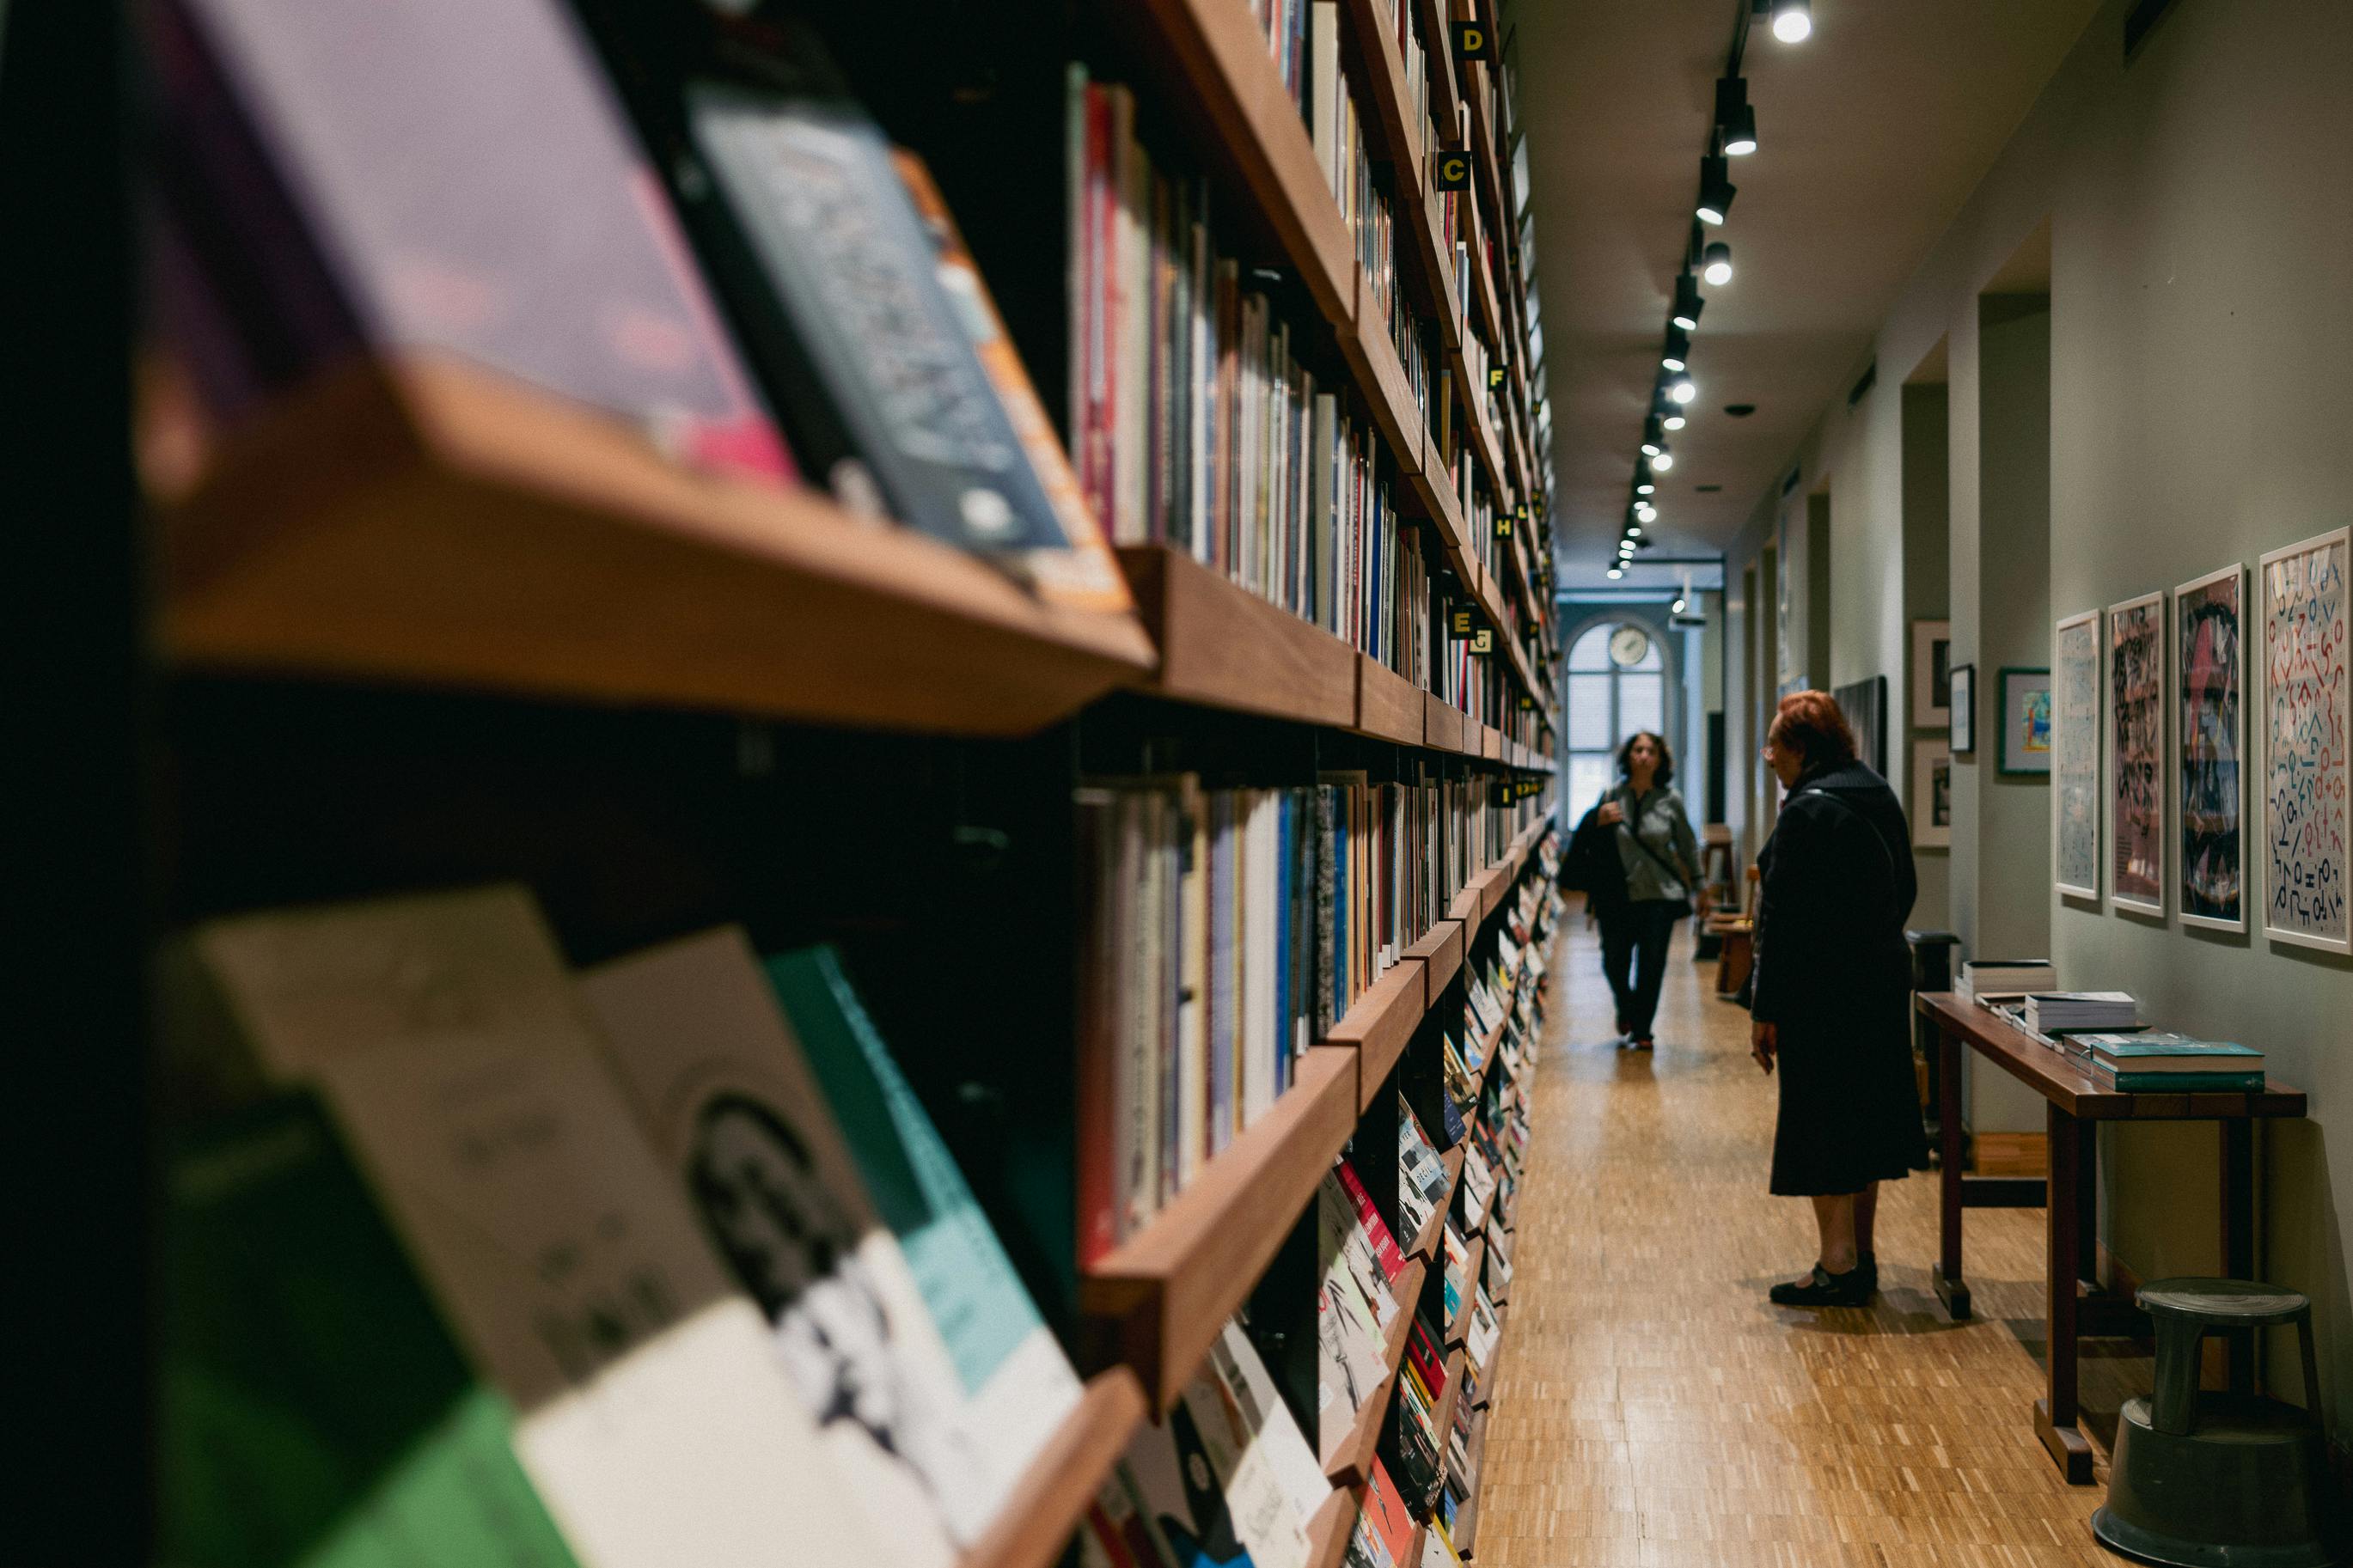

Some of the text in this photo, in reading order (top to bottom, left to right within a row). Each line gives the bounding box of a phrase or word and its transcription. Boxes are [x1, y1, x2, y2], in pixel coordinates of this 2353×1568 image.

[1464, 30, 1482, 51] D
[1444, 160, 1464, 181] C
[1491, 369, 1503, 386] F
[1518, 505, 1527, 519] L
[1497, 520, 1510, 535] H
[1454, 613, 1470, 632] E
